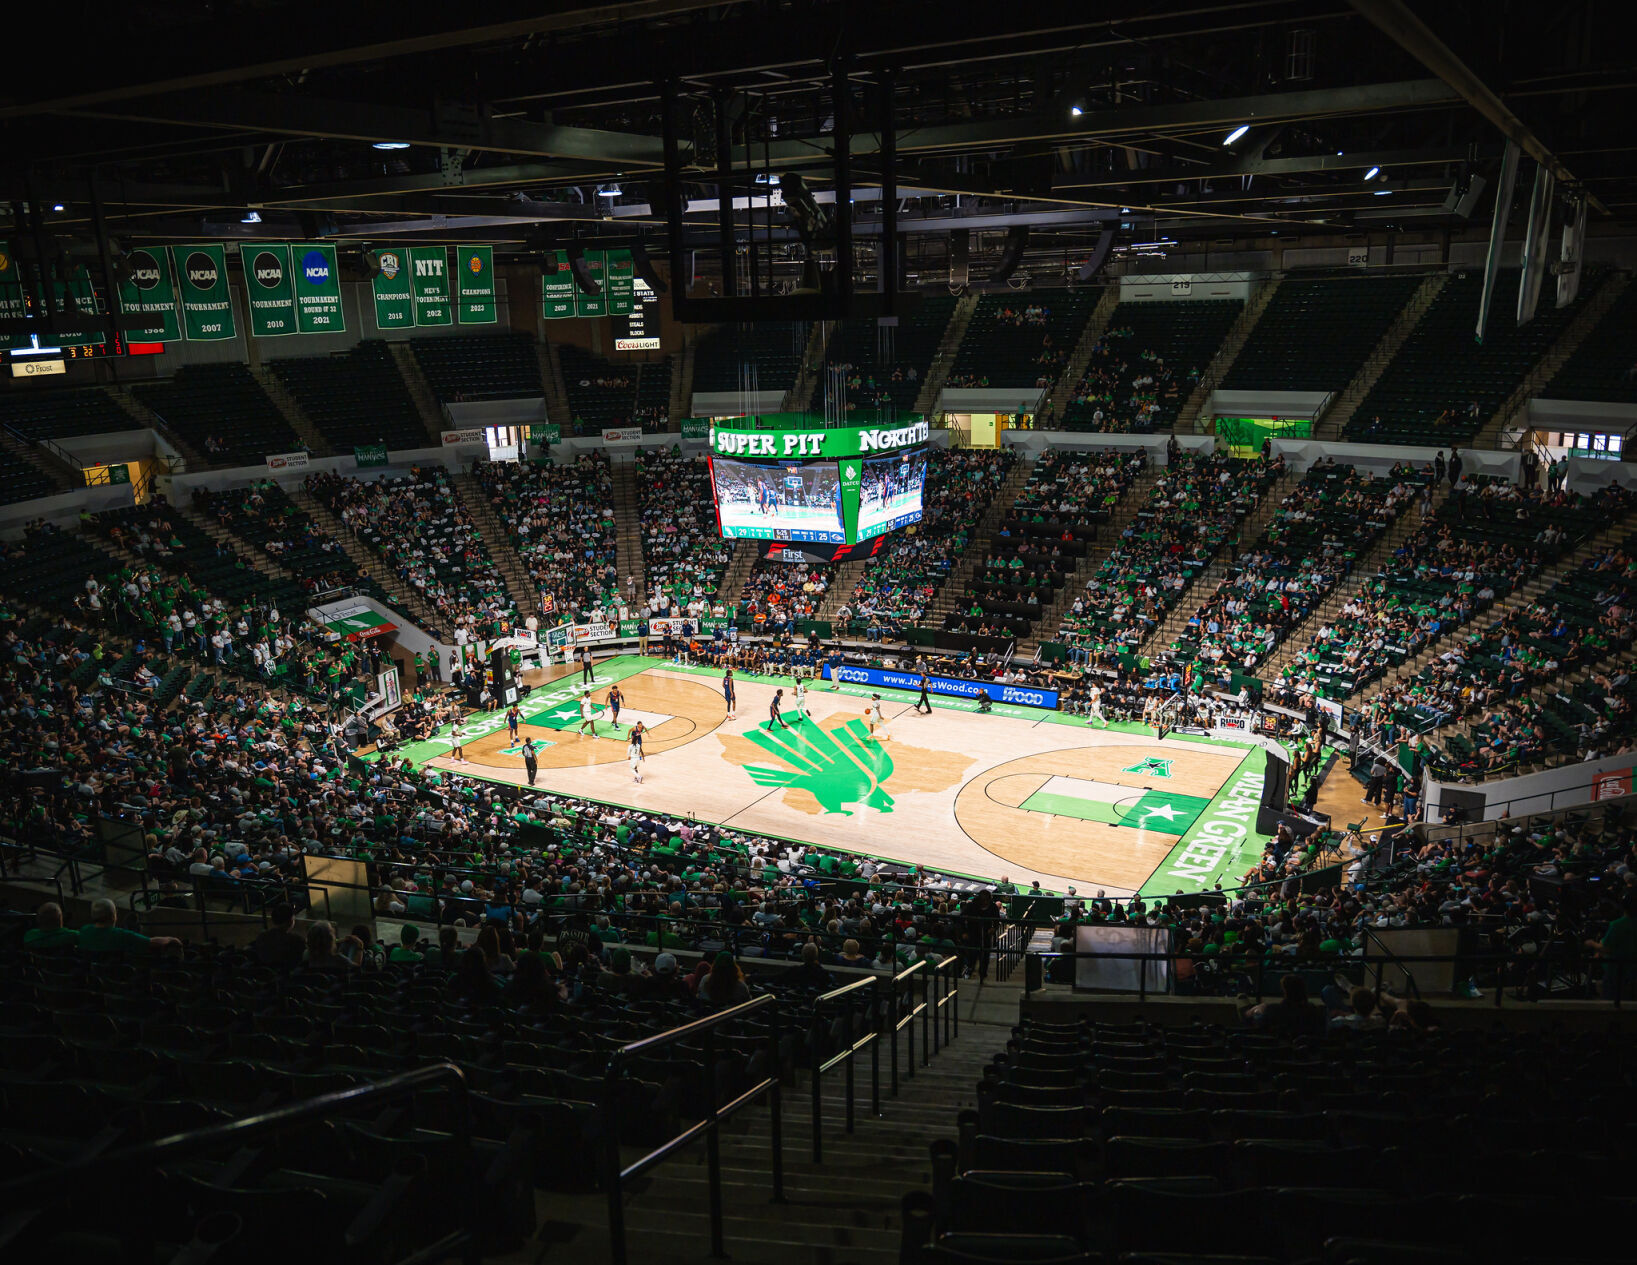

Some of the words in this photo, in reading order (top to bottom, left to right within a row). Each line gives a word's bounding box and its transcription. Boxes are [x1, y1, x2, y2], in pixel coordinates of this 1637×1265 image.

[306, 267, 329, 277] NCAA
[415, 259, 443, 276] NIT
[190, 270, 217, 280] NCAA
[258, 269, 282, 279] NCAA
[185, 302, 229, 311] TOURNAMENT
[253, 299, 292, 308] TOURNAMENT
[202, 324, 221, 332] 2007
[617, 341, 639, 349] Coors
[717, 431, 778, 455] SUPER
[782, 433, 825, 455] PIT
[858, 426, 916, 451] NORTH
[783, 549, 803, 558] First
[360, 627, 381, 637] Coca-Cola
[883, 675, 988, 694] www.JaesWood.co
[1002, 690, 1043, 705] WOOD
[1220, 718, 1245, 729] RHINO
[1214, 771, 1264, 822] MEAN
[1168, 821, 1247, 883] GREEN
